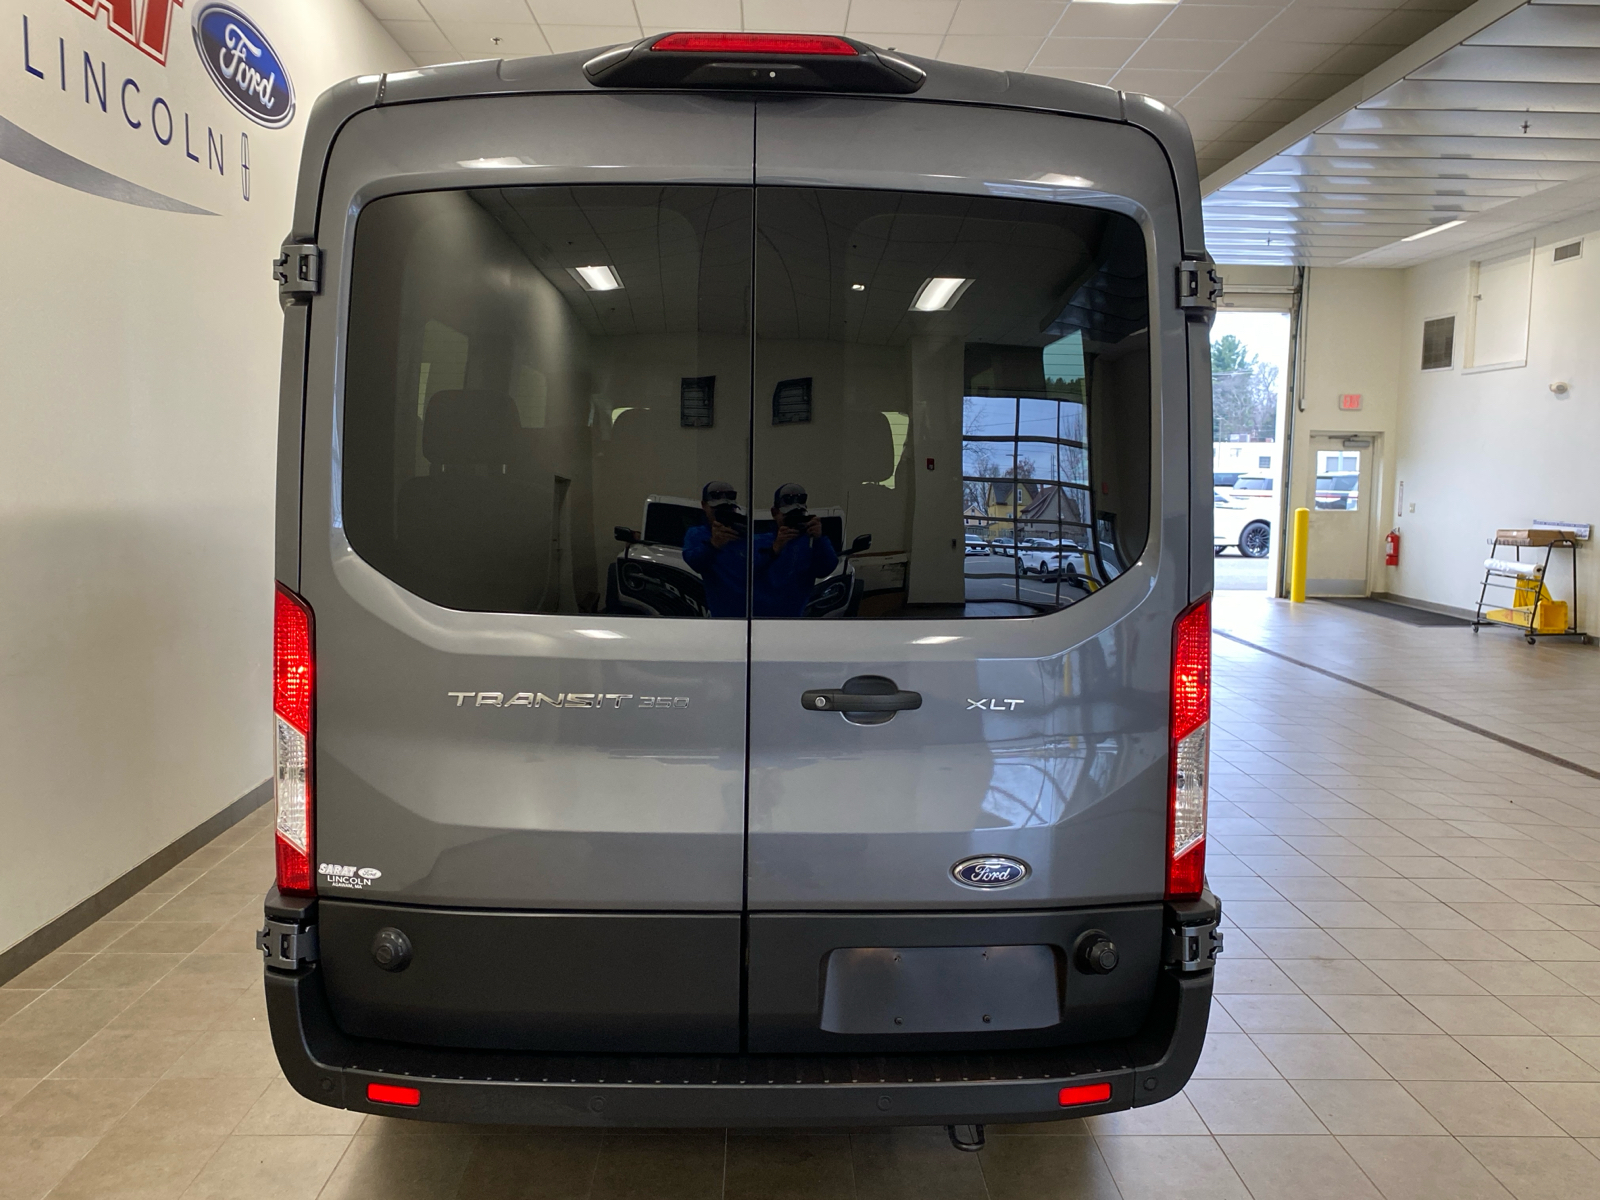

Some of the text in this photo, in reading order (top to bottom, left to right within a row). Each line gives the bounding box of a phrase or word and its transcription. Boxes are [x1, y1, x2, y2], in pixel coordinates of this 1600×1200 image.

[219, 23, 276, 110] Ford
[23, 14, 224, 176] LINCOLN
[447, 691, 690, 709] TRANSIT 350
[966, 698, 1025, 711] XLT
[318, 863, 357, 877] SARAT
[970, 863, 1011, 881] Ford
[327, 875, 371, 885] LINCOLN
